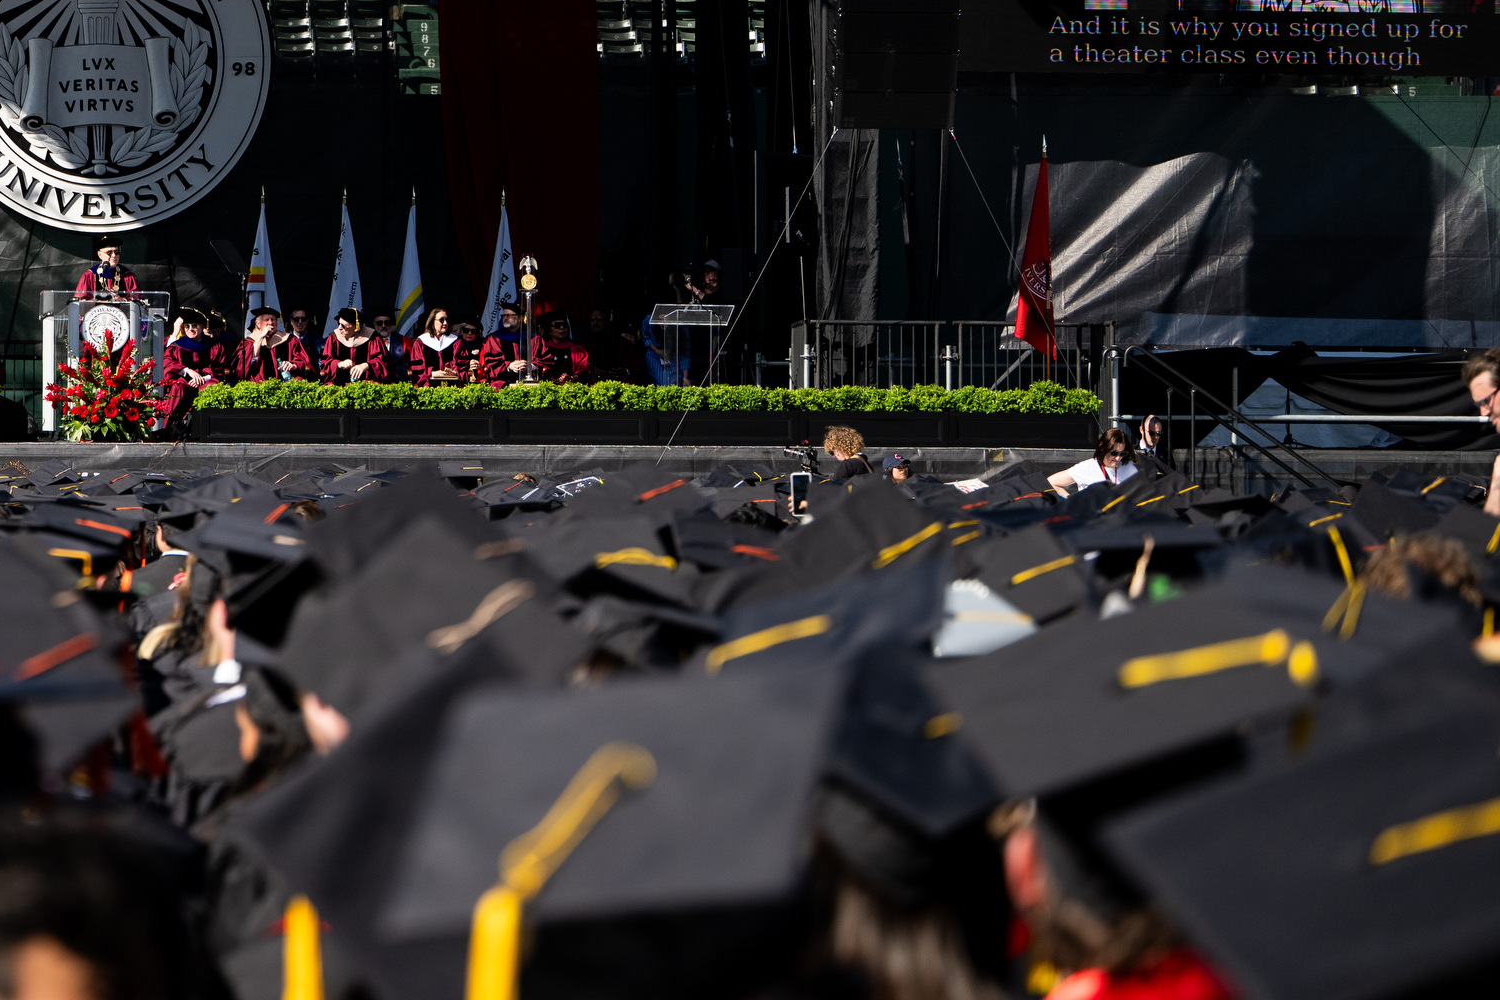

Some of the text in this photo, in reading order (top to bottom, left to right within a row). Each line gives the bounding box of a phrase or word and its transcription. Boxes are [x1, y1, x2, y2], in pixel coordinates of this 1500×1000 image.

[421, 22, 428, 32] 9
[1049, 16, 1468, 42] And it is why you signed up for
[423, 46, 431, 56] 7
[1049, 43, 1421, 71] a theater class even though
[82, 58, 116, 71] LVX
[231, 61, 256, 76] 98
[58, 78, 140, 93] VERITAS
[1408, 86, 1417, 97] 5
[64, 98, 134, 112] VIRTVS
